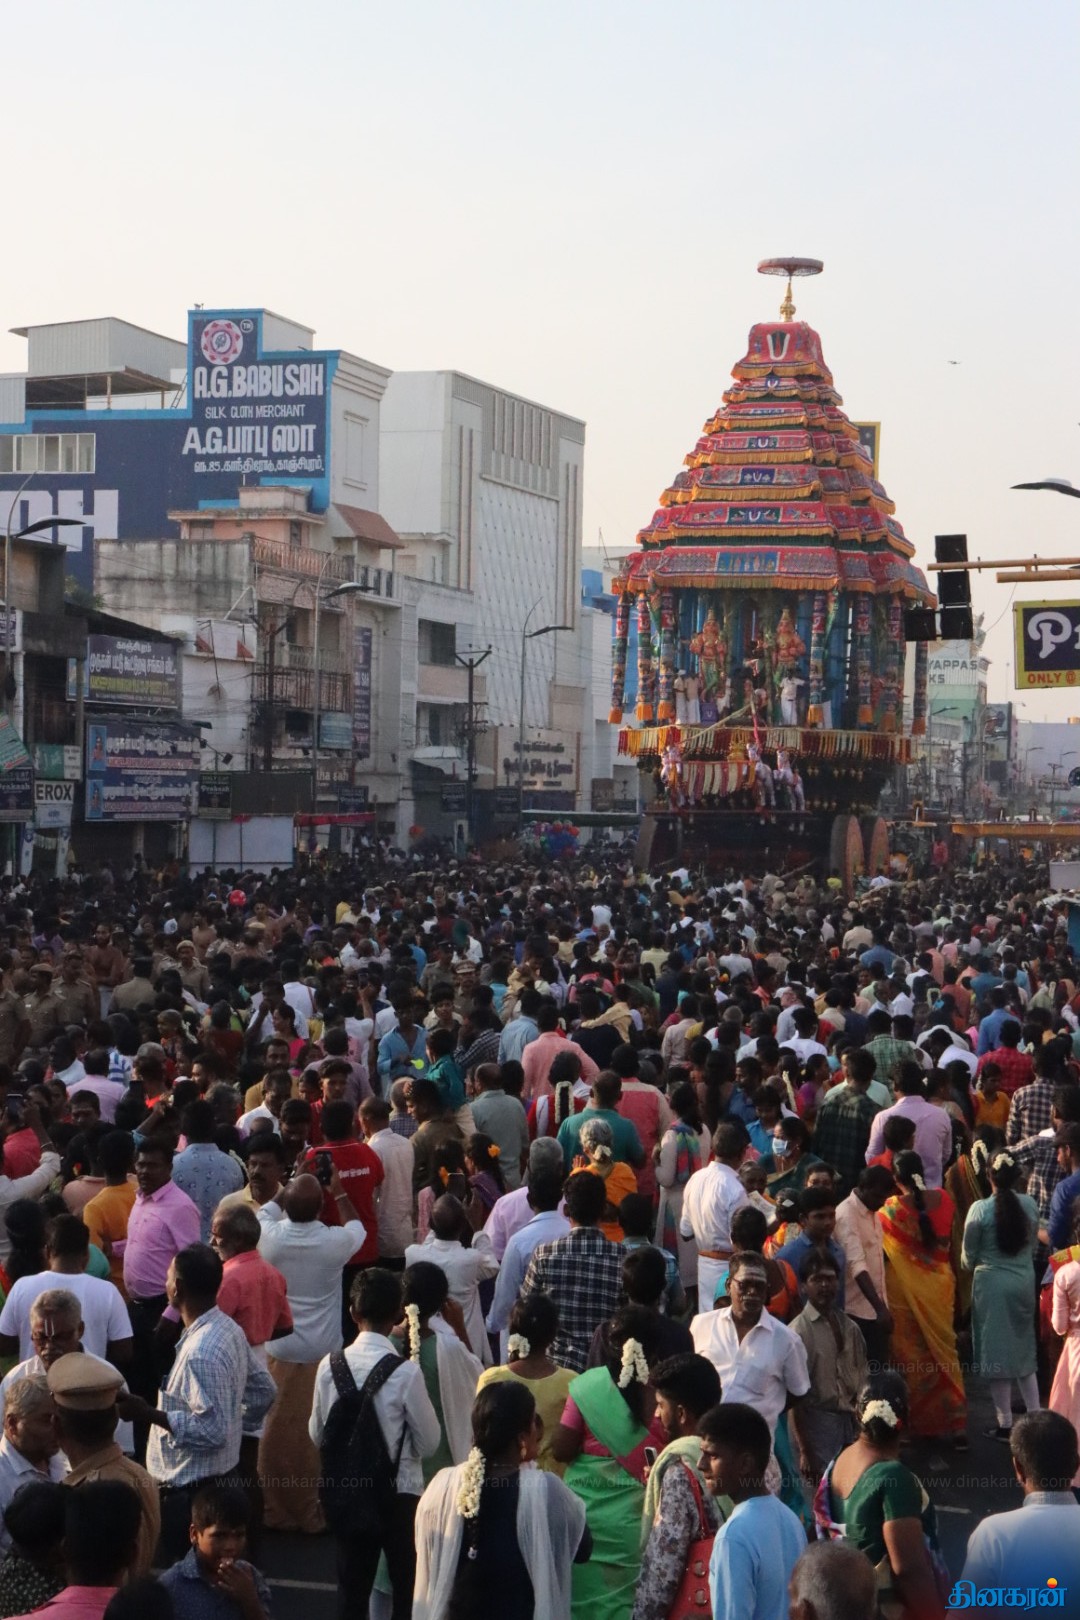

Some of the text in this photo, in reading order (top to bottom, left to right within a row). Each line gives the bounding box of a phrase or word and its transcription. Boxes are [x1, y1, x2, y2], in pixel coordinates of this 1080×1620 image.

[205, 404, 306, 419] SILK CLOTH MERCHANT
[1028, 672, 1061, 685] ONLY
